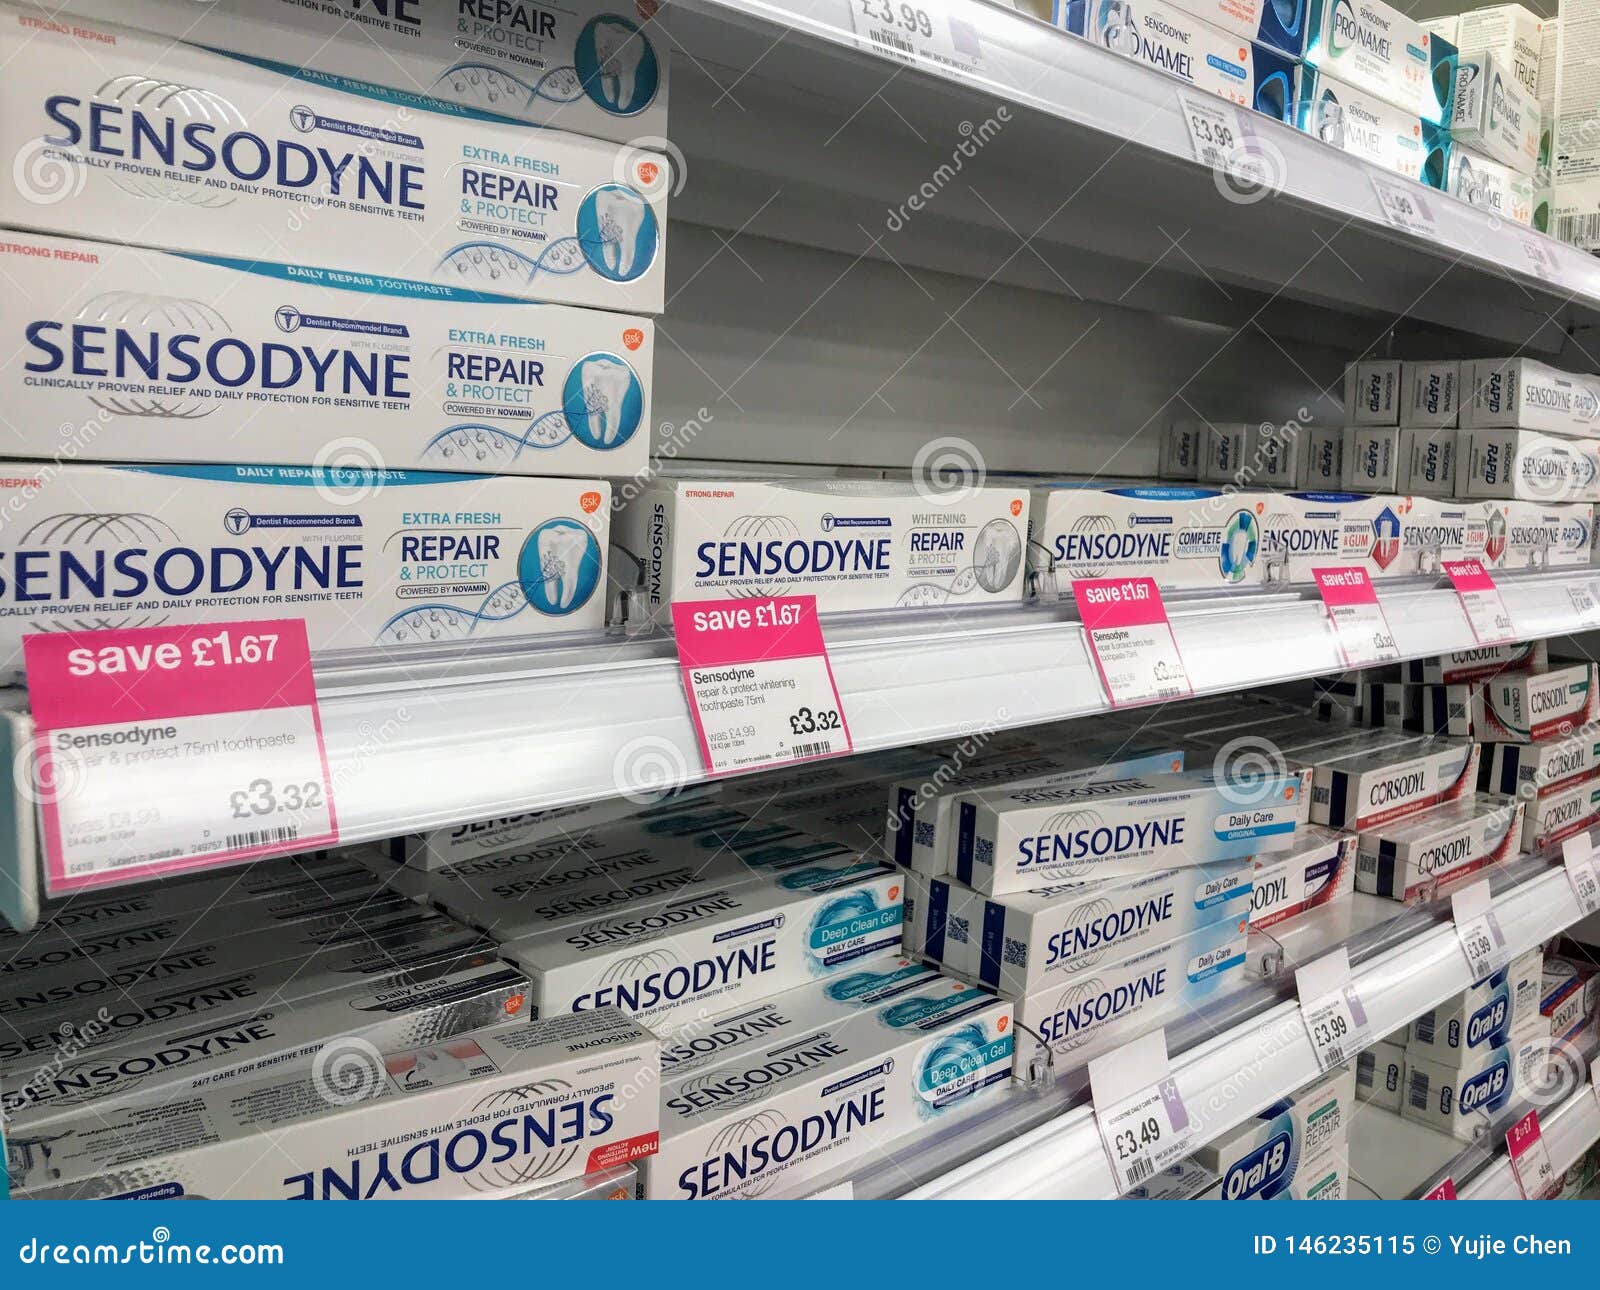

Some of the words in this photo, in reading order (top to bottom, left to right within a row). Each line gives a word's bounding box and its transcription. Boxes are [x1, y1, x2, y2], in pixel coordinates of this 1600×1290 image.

[18, 16, 70, 35] STRONG
[72, 27, 117, 46] REPAIR
[458, 0, 557, 39] REPAIR
[862, 0, 932, 38] £3.99
[1144, 15, 1191, 44] SENSODYNE
[1360, 7, 1391, 32] SENSODYNE
[1334, 12, 1393, 61] PRONAMEL
[1514, 61, 1536, 89] TRUE
[1349, 104, 1380, 126] SENSODYNE
[1192, 116, 1234, 149] £3.99
[44, 95, 426, 211] SENSODYNE
[462, 144, 510, 167] EXTRA
[514, 154, 560, 176] FRESH
[42, 149, 111, 169] CLINICALLY
[114, 161, 161, 179] PROVEN
[163, 170, 202, 185] RELIEF
[204, 176, 228, 190] AND
[230, 180, 261, 197] DAILY
[262, 187, 326, 207] PROTECTION
[327, 198, 347, 210] FOR
[348, 201, 396, 220] SENSITIVE
[397, 210, 425, 223] TEETH
[462, 168, 559, 211] REPAIR
[460, 199, 475, 216] &
[476, 201, 548, 227] PROTECT
[0, 242, 51, 259] STRONG
[53, 247, 100, 265] REPAIR
[286, 266, 325, 281] DAILY
[328, 271, 375, 287] REPAIR
[376, 278, 453, 298] TOOTHPASTE
[448, 328, 497, 347] EXTRA
[500, 333, 546, 352] FRESH
[24, 320, 411, 400] SENSODYNE
[447, 352, 545, 387] REPAIR
[24, 375, 94, 391] CLINICALLY
[97, 381, 145, 394] PROVEN
[148, 385, 187, 397] RELIEF
[189, 388, 212, 399] AND
[214, 390, 245, 402] DAILY
[246, 392, 309, 405] PROTECTION
[312, 396, 331, 407] FOR
[333, 397, 382, 410] SENSITIVE
[383, 400, 410, 411] TEETH
[446, 383, 459, 398] &
[462, 384, 533, 404] PROTECT
[1370, 373, 1381, 413] RAPID
[1428, 374, 1440, 414] RAPID
[1525, 384, 1572, 410] SENSODYNE
[1368, 440, 1379, 479] RAPID
[1426, 442, 1438, 482] RAPID
[1486, 443, 1498, 485] RAPID
[685, 490, 711, 499] STRONG
[713, 490, 735, 499] REPAIR
[402, 512, 451, 525] EXTRA
[455, 512, 501, 525] FRESH
[911, 513, 966, 525] WHITENING
[401, 535, 500, 562] REPAIR
[910, 532, 964, 552] REPAIR
[1055, 532, 1170, 562] SENSODYNE
[1177, 542, 1221, 555] PROTECTION
[1179, 531, 1222, 544] COMPLETE
[1349, 534, 1368, 547] GUM
[1404, 527, 1464, 545] SENSODYNE
[1511, 527, 1559, 544] SENSODYNE
[1561, 527, 1580, 541] RAPID
[651, 503, 664, 605] SENSODYNE
[695, 539, 891, 578] SENSODYNE
[400, 566, 411, 580] &
[416, 564, 487, 580] PROTECT
[1322, 574, 1344, 587] save
[400, 586, 439, 596] POWERED
[440, 585, 451, 595] BY
[452, 583, 487, 594] NOVAMIN
[1086, 587, 1121, 604] save
[1122, 581, 1150, 600] £1.67
[694, 608, 751, 632] save
[755, 601, 801, 627] £1.67
[1093, 630, 1129, 642] Sensodyne
[68, 642, 182, 677] save
[191, 630, 279, 668] £1.67
[693, 667, 755, 685] Sensodyne
[696, 686, 719, 700] repair
[721, 685, 729, 695] &
[730, 682, 758, 698] protect
[758, 678, 795, 692] whitening
[700, 697, 744, 712] toothpaste
[745, 694, 765, 706] 75ml
[1531, 686, 1568, 714] CORSODYL
[708, 731, 728, 743] was
[729, 725, 756, 740] £4.99
[790, 707, 841, 735] £3.32
[57, 723, 177, 752] Sensodyne
[1548, 748, 1585, 778] CORSODYL
[230, 778, 323, 819] £3.32
[1370, 771, 1426, 806] CORSODYL
[1229, 813, 1252, 828] Daily
[1253, 811, 1275, 824] Care
[1544, 797, 1582, 829] CORSODYL
[1017, 817, 1185, 867] SENSODYNE
[1227, 829, 1257, 839] ORIGINAL
[1418, 835, 1472, 875] CORSODYL
[1205, 880, 1222, 896] Daily
[1223, 876, 1238, 889] Care
[1577, 878, 1597, 899] £3.99
[565, 896, 742, 951] SENSODYNE
[821, 926, 848, 943] Deep
[850, 917, 879, 936] Clean
[880, 910, 897, 925] Gel
[1046, 893, 1174, 965] SENSODYNE
[826, 942, 846, 955] DAILY
[847, 936, 866, 949] CARE
[1198, 953, 1216, 969] Daily
[1217, 947, 1232, 960] Care
[1468, 936, 1491, 960] £3.99
[571, 940, 776, 1013] SENSODYNE
[1039, 969, 1167, 1045] SENSODYNE
[1469, 1001, 1506, 1042] Oral-B
[566, 1031, 643, 1052] SENSODYNE
[1314, 1015, 1347, 1048] £3.99
[192, 1075, 213, 1089] 24/7
[213, 1070, 237, 1085] CARE
[238, 1066, 256, 1079] FOR
[257, 1052, 299, 1072] SENSITIVE
[300, 1044, 325, 1059] TEETH
[666, 1040, 849, 1115] SENSODYNE
[931, 1064, 958, 1084] Deep
[960, 1053, 988, 1072] Clean
[990, 1043, 1006, 1059] Gel
[571, 1082, 615, 1099] SPECIALLY
[936, 1082, 955, 1096] DAILY
[956, 1074, 975, 1088] CARE
[1462, 1066, 1506, 1107] Oral-B
[492, 1106, 511, 1117] FOR
[513, 1090, 570, 1113] FORMULATED
[427, 1118, 455, 1134] WITH
[456, 1110, 492, 1124] PEOPLE
[283, 1094, 615, 1200] SENSODYNE
[379, 1126, 428, 1147] SENSITIVE
[678, 1086, 886, 1200] SENSODYNE
[1115, 1117, 1161, 1160] £3.49
[1305, 1119, 1341, 1148] REPAIR
[347, 1140, 379, 1157] TEETH
[630, 1141, 658, 1157] new
[1228, 1140, 1286, 1200] Oral-B
